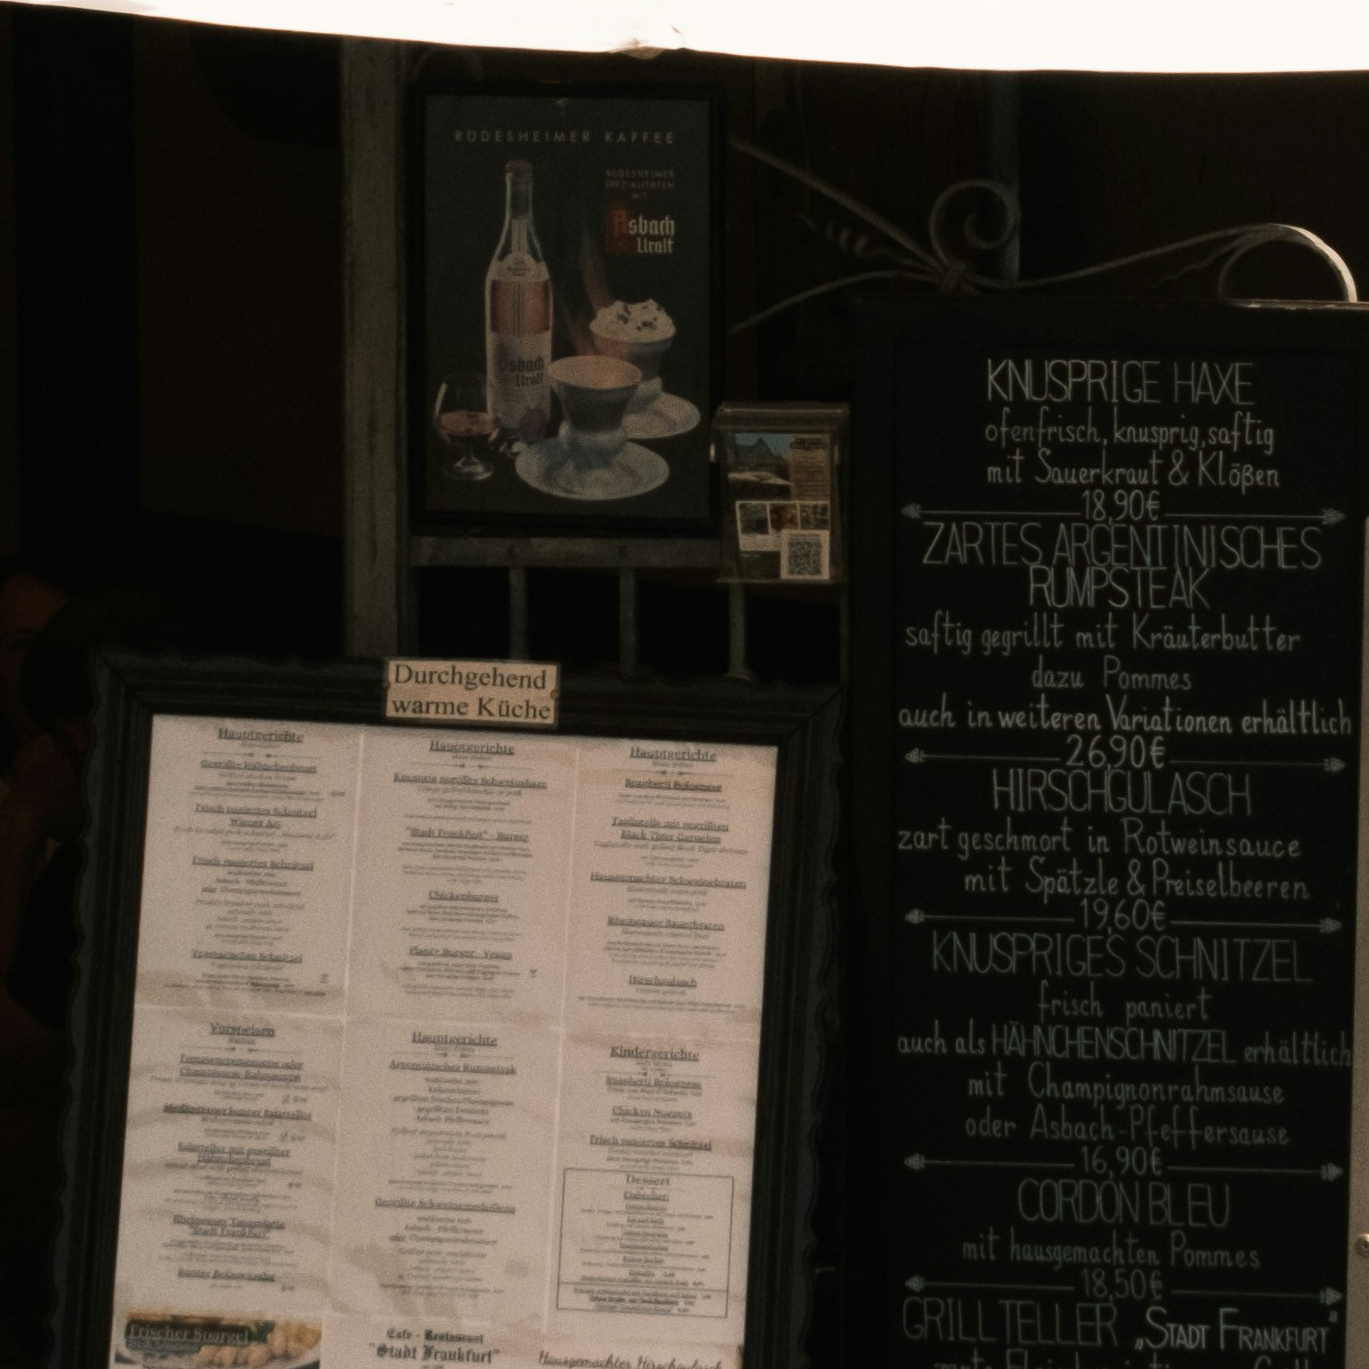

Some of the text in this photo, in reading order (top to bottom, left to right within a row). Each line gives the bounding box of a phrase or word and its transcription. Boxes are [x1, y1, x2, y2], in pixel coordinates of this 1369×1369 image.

[454, 129, 674, 144] RÜDESHEIMER KAFFEE
[614, 210, 675, 238] Asbach
[637, 237, 674, 253] Uralt
[987, 358, 1254, 405] KNUSPRIGE HAXE
[985, 406, 1108, 448] ofenfrisch,
[1208, 410, 1274, 454] saftig
[987, 448, 1280, 495] mit Sauerkraut & Klößen
[1081, 489, 1161, 526] 18,90€
[922, 522, 1323, 569] ZARTES ARGENTINISCHES
[1029, 566, 1210, 609] RUMPSTEAK
[905, 609, 1301, 655] saftig gegrillt mit Kräuterbutter
[395, 664, 547, 691] Durchgehend
[1032, 655, 1192, 691] dazu Pommes
[392, 697, 551, 720] warme Küche
[898, 693, 1353, 735] auch in weiteren Variationen erhältlich
[218, 728, 303, 743] Hauptgerichte
[429, 740, 515, 756] Hauptgerichte
[1066, 734, 1165, 770] 26,90€
[630, 746, 717, 762] Hauptgerichte
[992, 768, 1251, 816] HIRSCHGULASCH
[898, 817, 1301, 861] zart geschmort in Rotweinsauce
[965, 856, 1310, 904] mit Spätzle & Preiselbeeren
[1079, 898, 1165, 934] 19,60€
[932, 931, 1314, 983] KNUSPRIGES SCHNITZEL
[1038, 979, 1212, 1021] frisch paniert
[412, 1032, 497, 1047] Hauptgerichte
[610, 1045, 699, 1062] Kindergerichte
[898, 1019, 1352, 1068] auch als HÄHNCHENSCHNITZEL erhältlich
[968, 1060, 1008, 1098] mit
[965, 1104, 1016, 1138] oder
[626, 1173, 670, 1186] Dessert
[1081, 1146, 1162, 1179] 16,90€
[1018, 1178, 1231, 1228] CORDON BLEU
[962, 1227, 1261, 1271] mit hausgemachten Pommes
[1080, 1269, 1163, 1305] 18,50€
